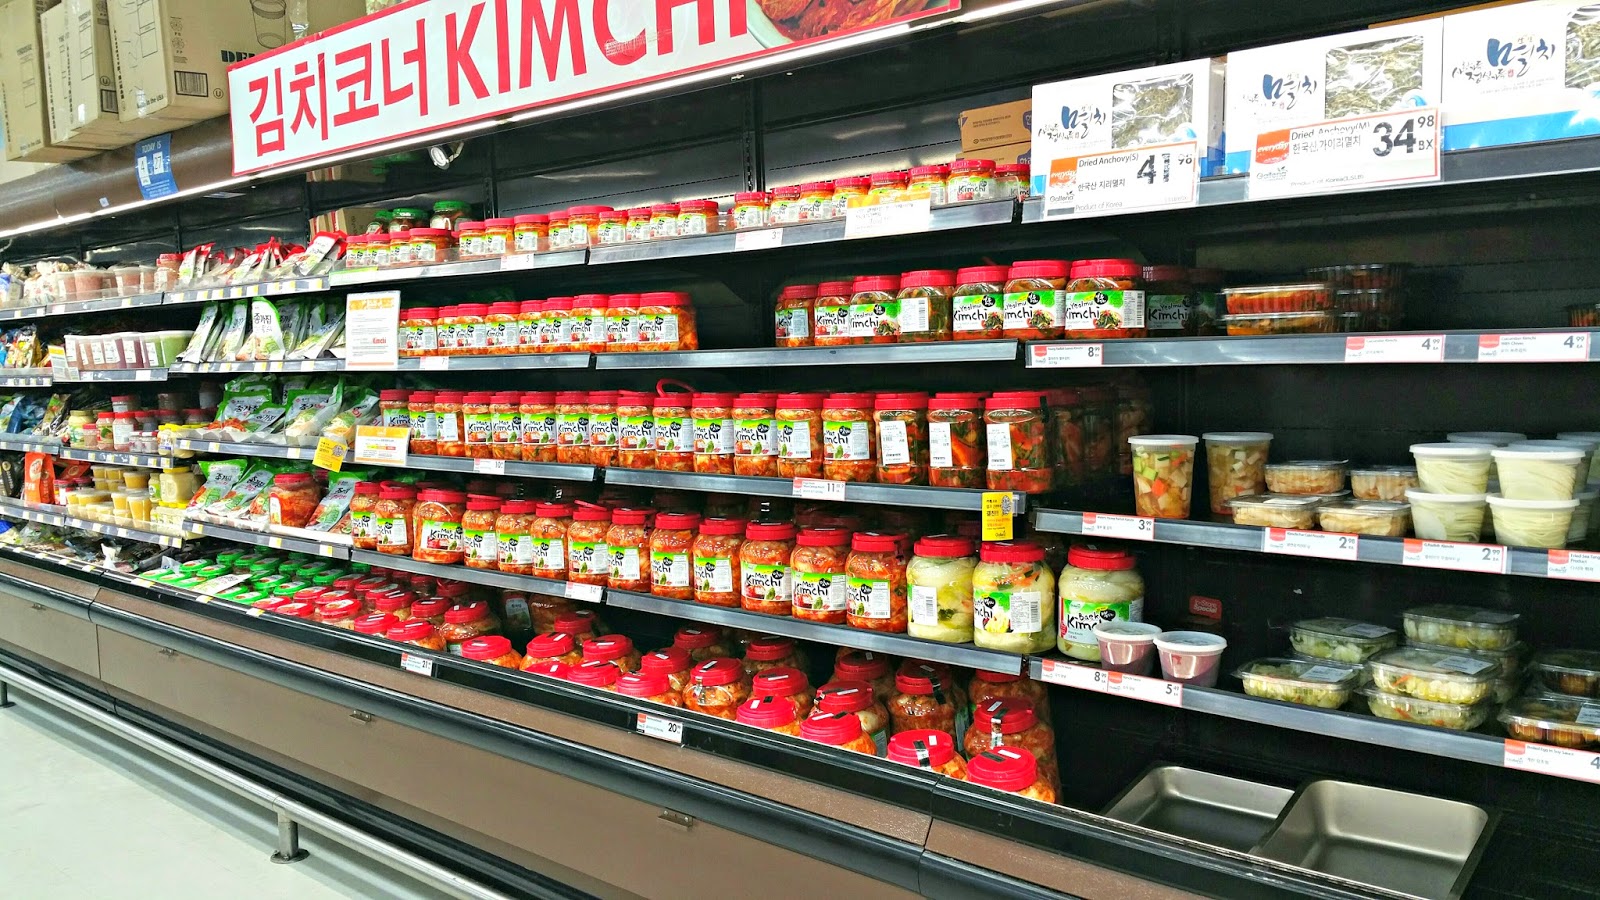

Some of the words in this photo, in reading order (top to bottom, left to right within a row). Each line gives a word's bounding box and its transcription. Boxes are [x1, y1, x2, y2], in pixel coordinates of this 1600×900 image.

[248, 18, 429, 157] 김치코너
[1417, 115, 1434, 128] 98
[1291, 129, 1315, 140] Dried
[1372, 118, 1417, 157] 34
[142, 142, 155, 153] TODAY
[1418, 140, 1434, 151] BX
[1079, 157, 1098, 168] Dried
[1098, 153, 1139, 165] Anchovy(S)
[1137, 153, 1170, 184] 41
[958, 185, 986, 194] Kimchi
[1075, 203, 1095, 211] Product
[1104, 201, 1123, 209] Korea
[953, 307, 988, 321] Kimchi
[1004, 307, 1033, 319] imchi
[1065, 307, 1100, 319] Kimchi
[1148, 307, 1189, 320] Kimchi
[816, 315, 846, 326] Kimchi
[850, 316, 879, 329] imchi
[1421, 338, 1431, 350] 4
[1563, 335, 1574, 348] 4
[1088, 346, 1095, 357] 8
[493, 422, 521, 432] Kimchi
[523, 422, 553, 433] Kimchi
[558, 423, 587, 433] Kimchi
[591, 423, 619, 433] Kimchi
[620, 426, 651, 437] Kimchi
[656, 427, 679, 438] imchi
[694, 428, 719, 440] imchi
[735, 429, 767, 442] Kimchi
[1138, 519, 1145, 530] 3
[430, 528, 462, 541] Kimchi
[1339, 536, 1347, 549] 2
[571, 551, 592, 562] imchi
[1482, 547, 1491, 561] 2
[745, 572, 781, 587] Kimchi
[794, 580, 829, 597] Kimchi
[847, 588, 870, 603] mchi
[974, 604, 993, 618] mchi
[1193, 605, 1218, 613] Special
[1094, 671, 1100, 682] 8
[1166, 684, 1173, 694] 5
[668, 722, 677, 732] 20
[1590, 756, 1600, 769] 4
